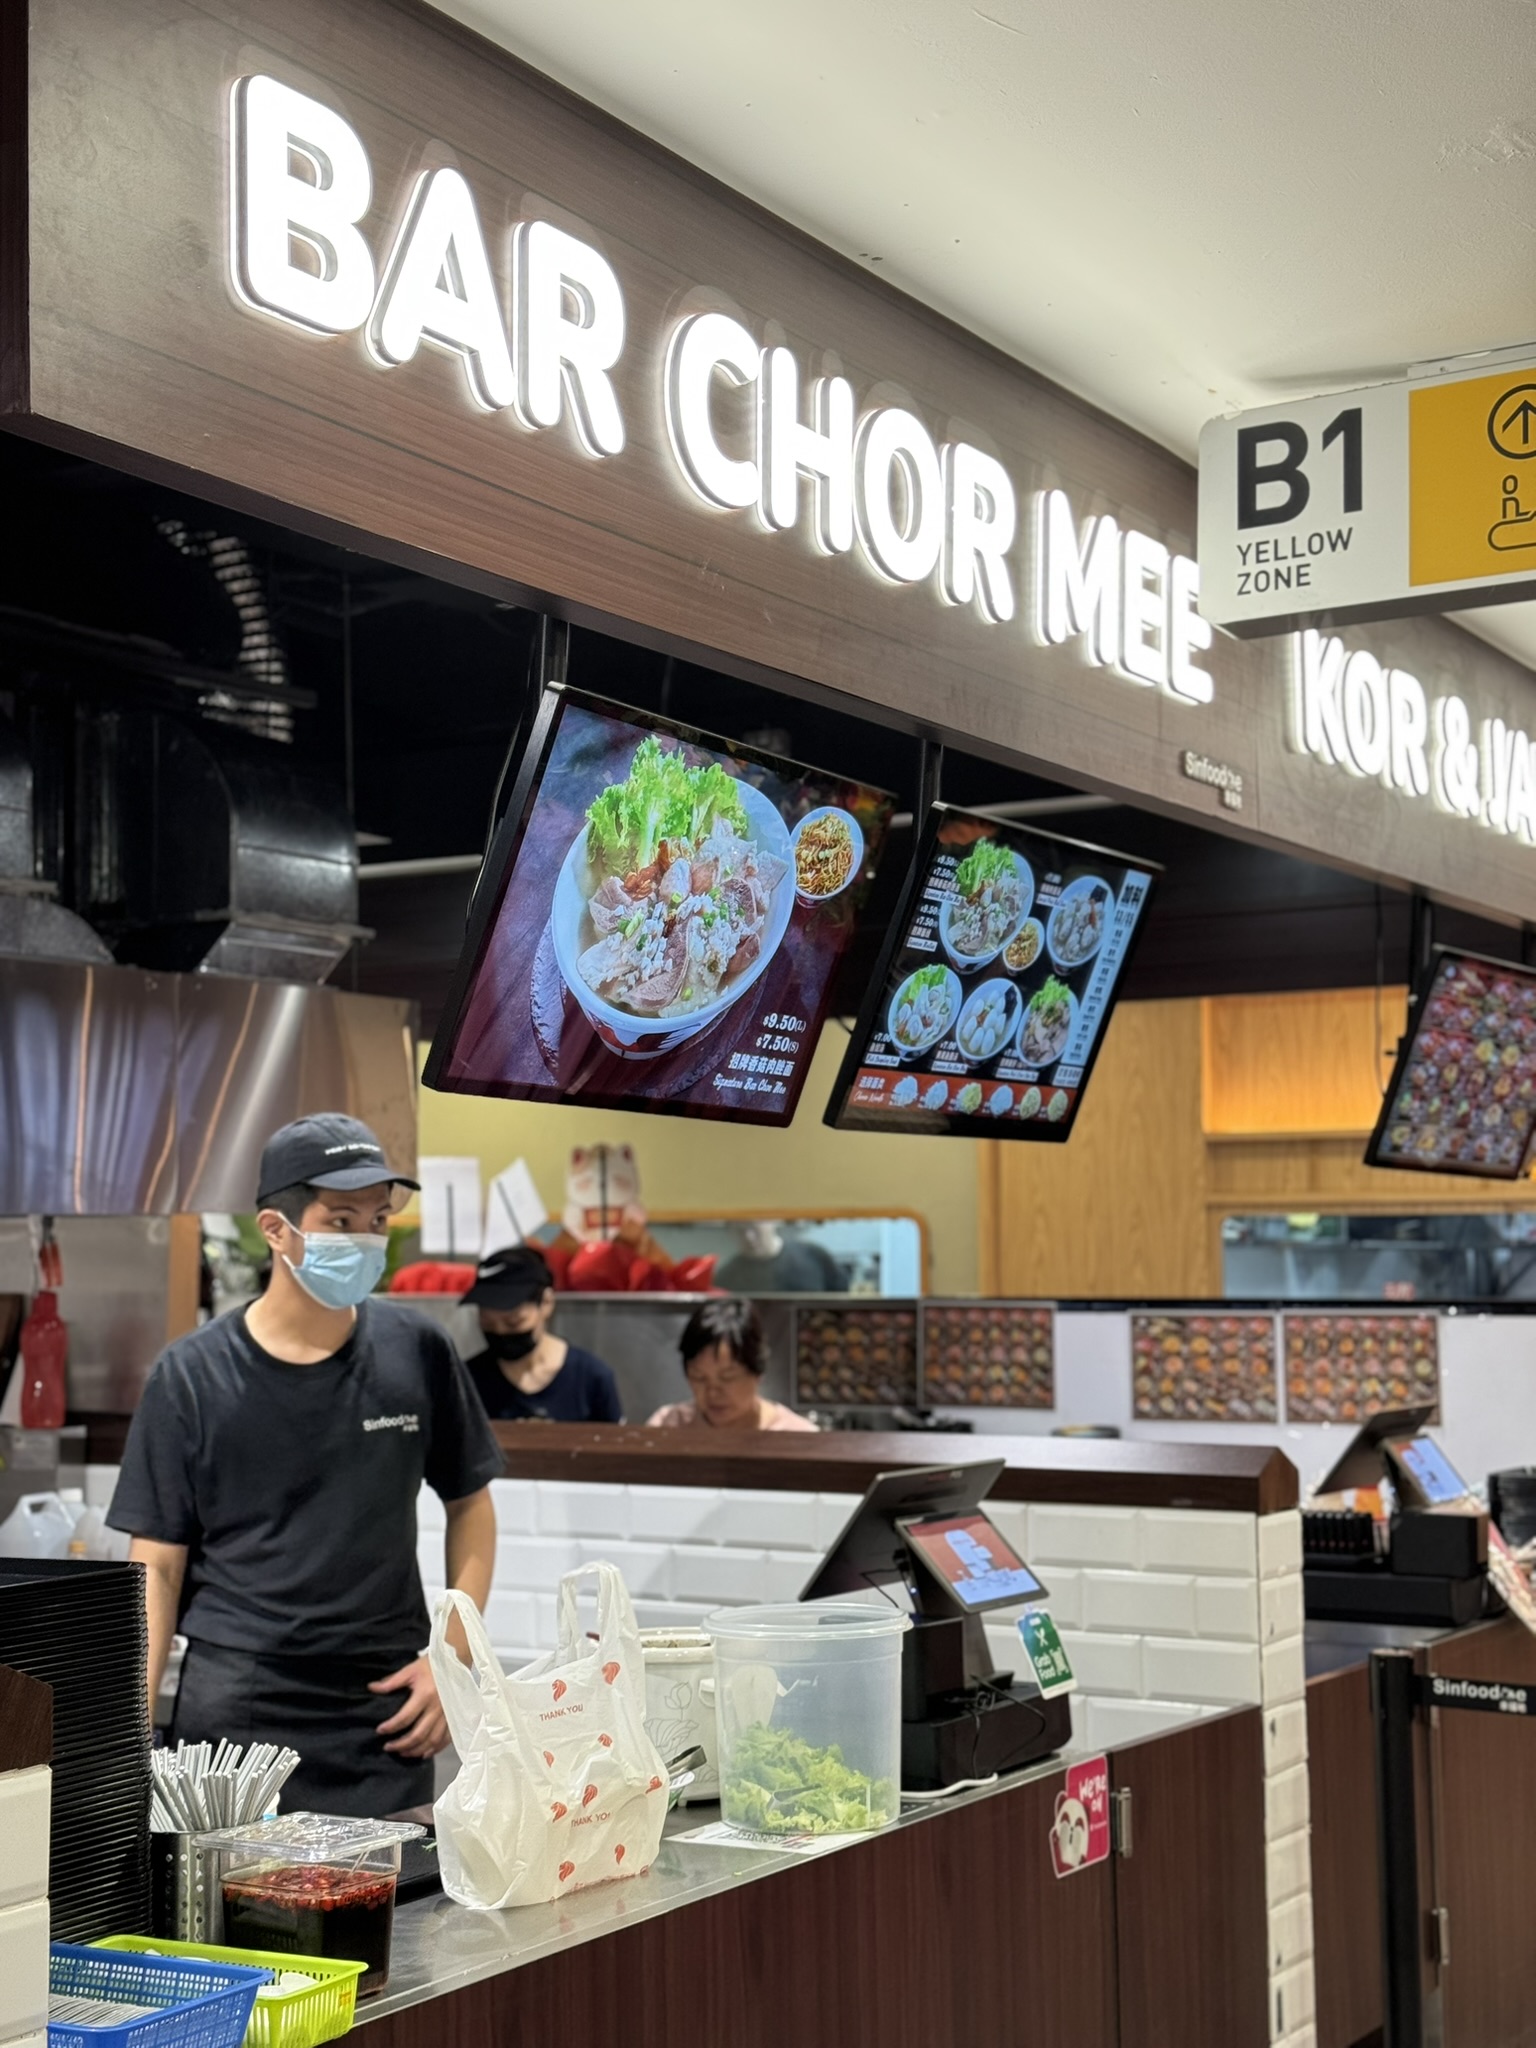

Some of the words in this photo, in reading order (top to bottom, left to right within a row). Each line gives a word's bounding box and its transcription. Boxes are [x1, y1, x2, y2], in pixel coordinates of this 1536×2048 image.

[229, 73, 625, 459] BAR
[665, 312, 1015, 623] CHOR
[1034, 489, 1214, 706] MEE
[1237, 407, 1363, 531] B1
[1236, 527, 1354, 567] YELLOW
[1236, 563, 1312, 597] ZONE
[1292, 628, 1430, 798] KOR
[1434, 695, 1480, 819] &
[539, 1707, 566, 1721] THANK
[566, 1703, 584, 1713] YOU
